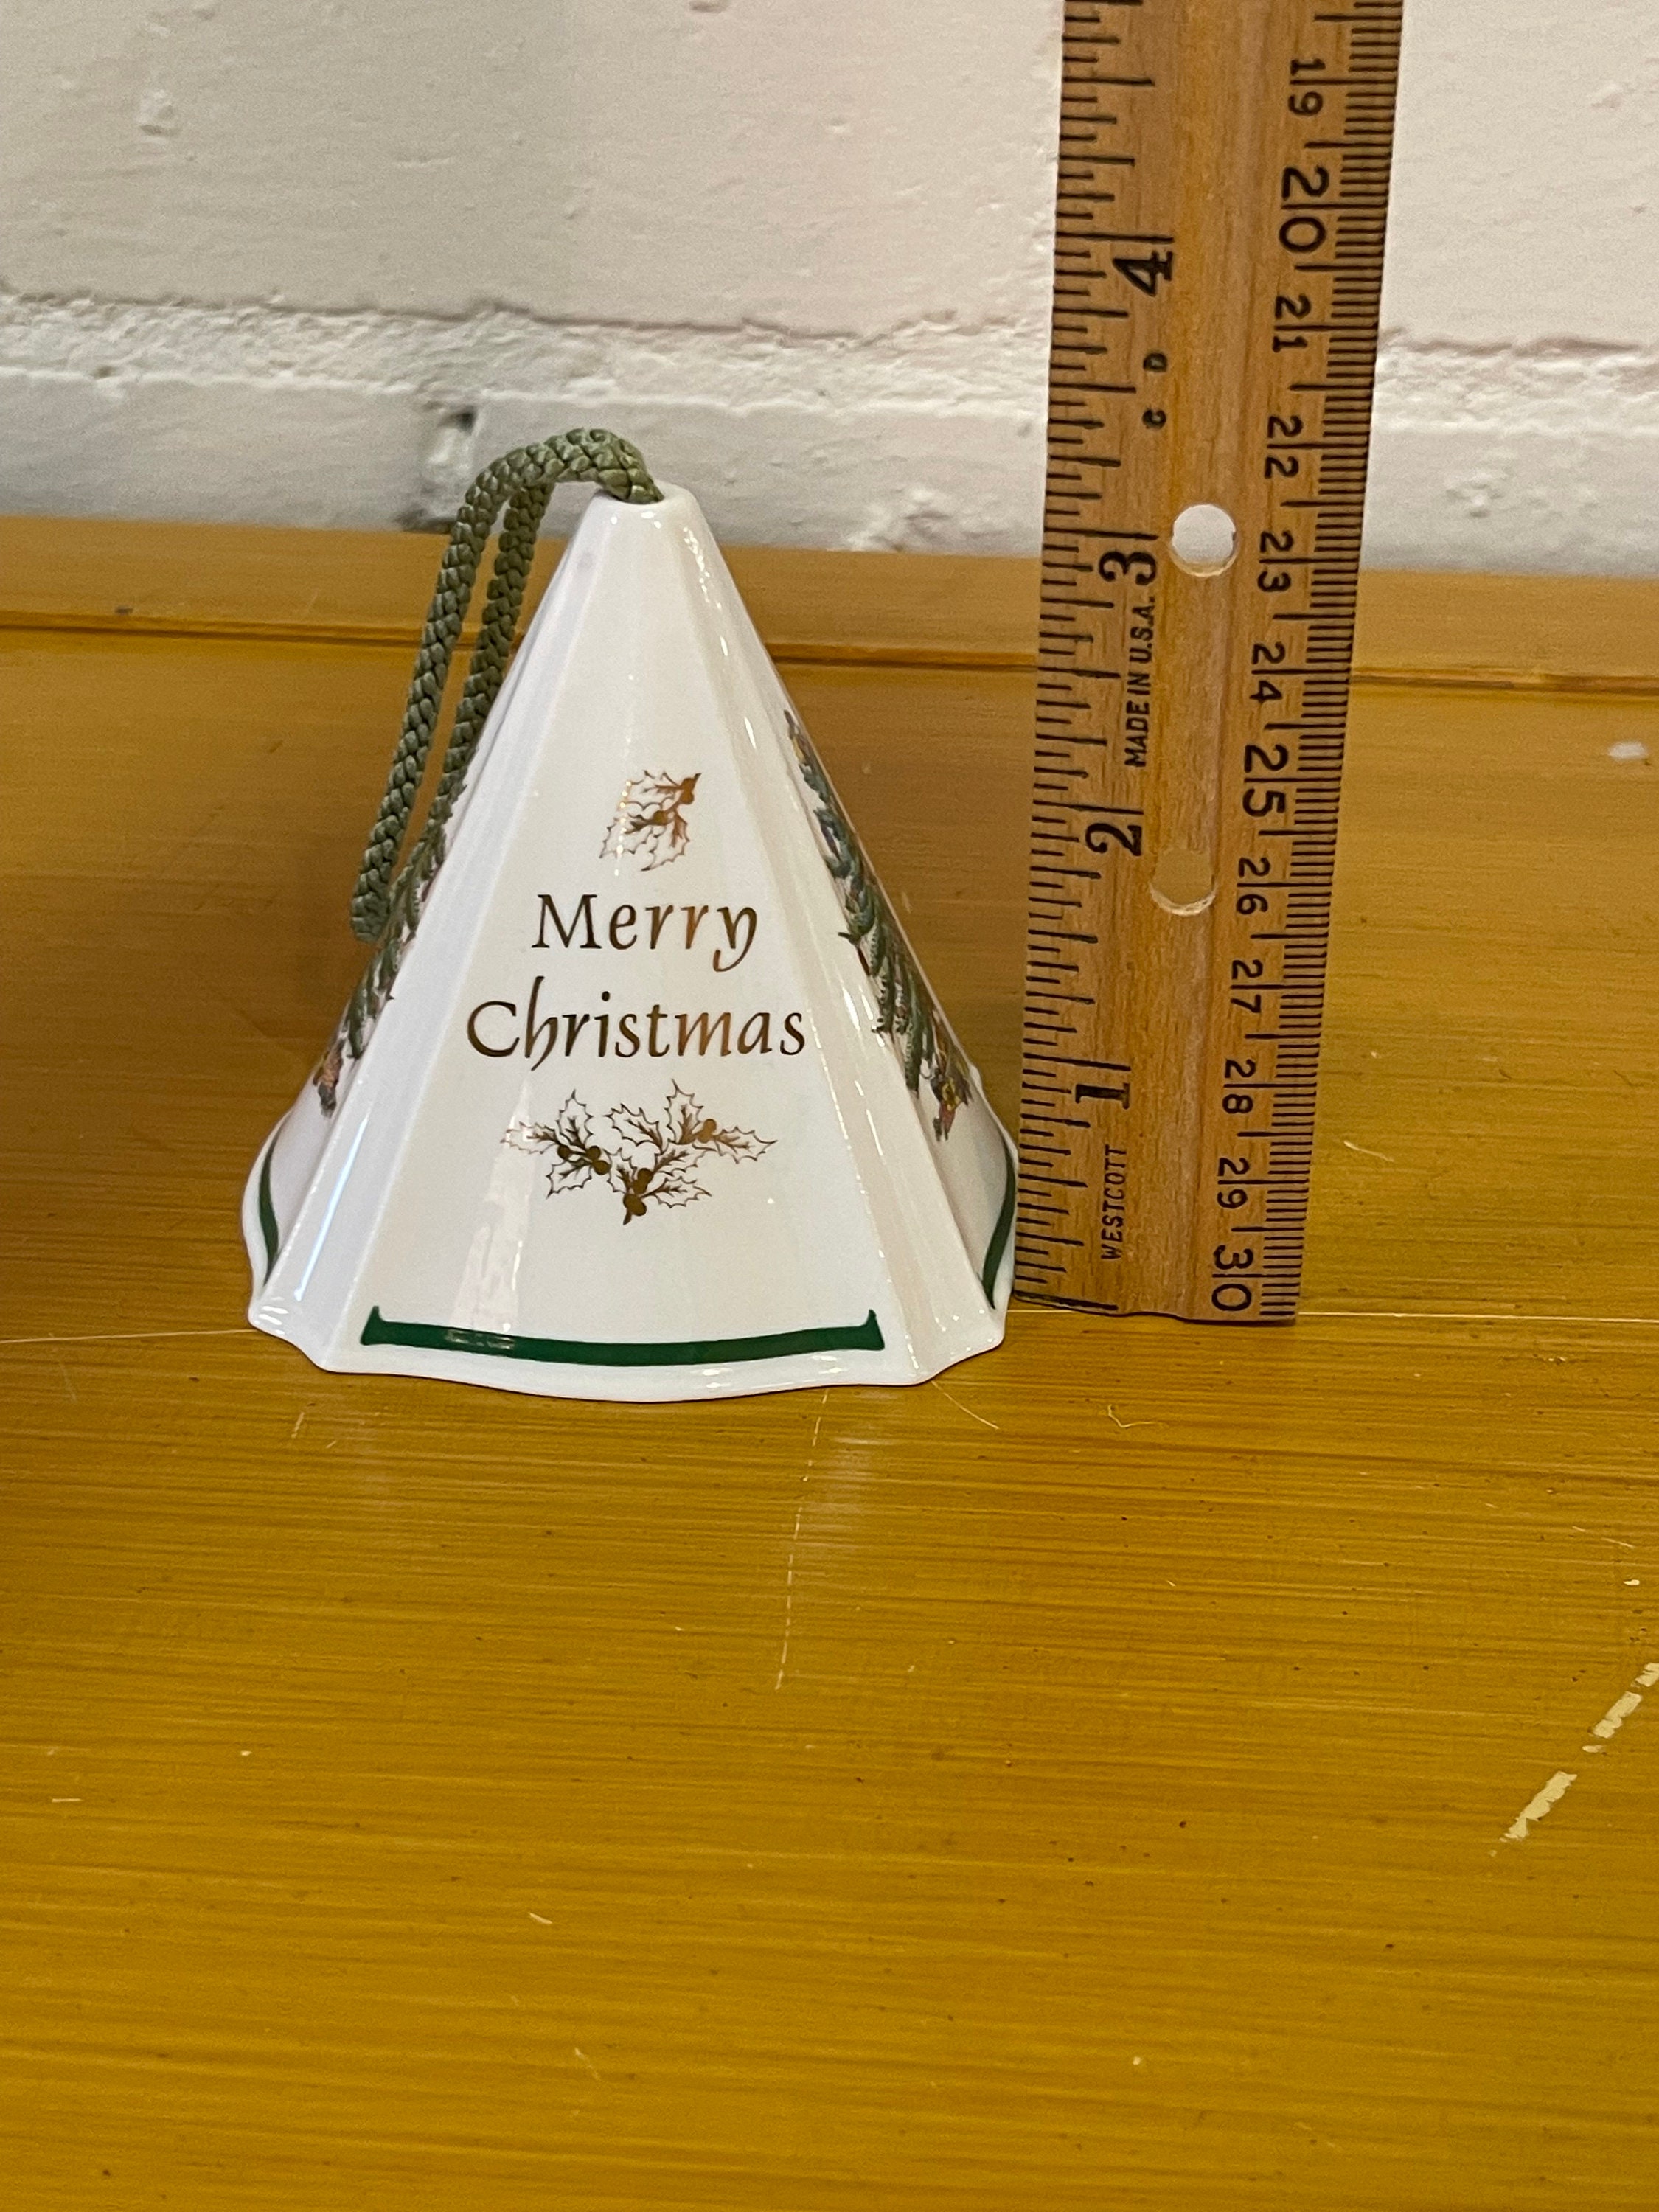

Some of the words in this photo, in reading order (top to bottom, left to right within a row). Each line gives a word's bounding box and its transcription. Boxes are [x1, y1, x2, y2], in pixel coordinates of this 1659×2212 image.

[1288, 58, 1326, 116] 19
[1279, 166, 1329, 254] 20
[1113, 251, 1173, 296] 4
[1272, 294, 1311, 353] 21
[1265, 414, 1303, 480] 22
[1099, 550, 1157, 587] 3
[1257, 530, 1294, 592] 23
[1130, 595, 1156, 663] U.S.A.
[1127, 673, 1150, 697] IN
[1250, 641, 1286, 704] 24
[1124, 698, 1150, 768] MADE
[1242, 744, 1288, 818] 25
[1085, 822, 1143, 857] 2
[1237, 857, 1271, 917] 26
[531, 894, 757, 972] Merry
[1231, 959, 1264, 1014] 27
[467, 975, 806, 1071] Christmas
[1075, 1082, 1130, 1110] 1
[1222, 1059, 1256, 1115] 28
[1101, 1144, 1127, 1259] WESTCOTT
[1217, 1157, 1251, 1209] 29
[1211, 1245, 1254, 1312] 30
